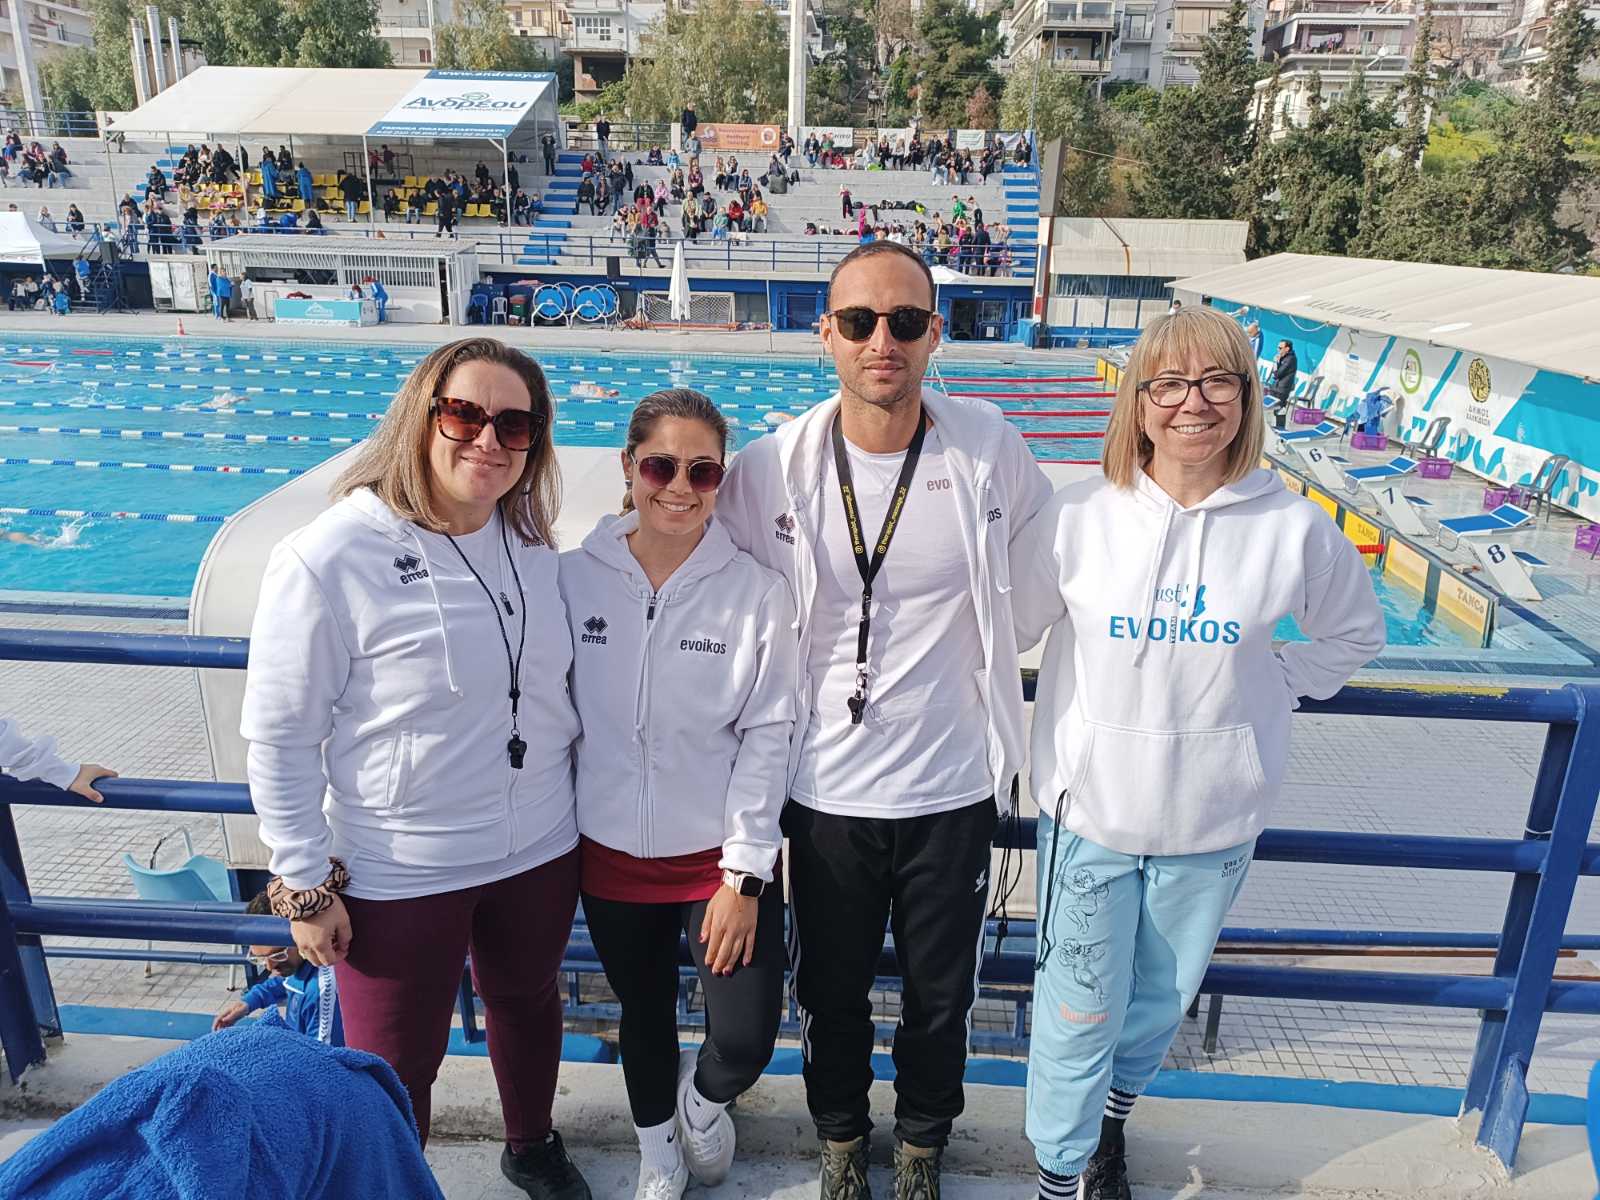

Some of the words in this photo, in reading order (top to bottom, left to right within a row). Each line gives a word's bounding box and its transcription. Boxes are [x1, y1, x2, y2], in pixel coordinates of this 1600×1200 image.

[1309, 448, 1322, 462] 6
[1382, 487, 1394, 504] 7
[1487, 544, 1506, 564] 8
[400, 568, 429, 585] errea
[1154, 583, 1182, 603] ust
[581, 633, 608, 645] errea
[679, 638, 728, 655] evoikos
